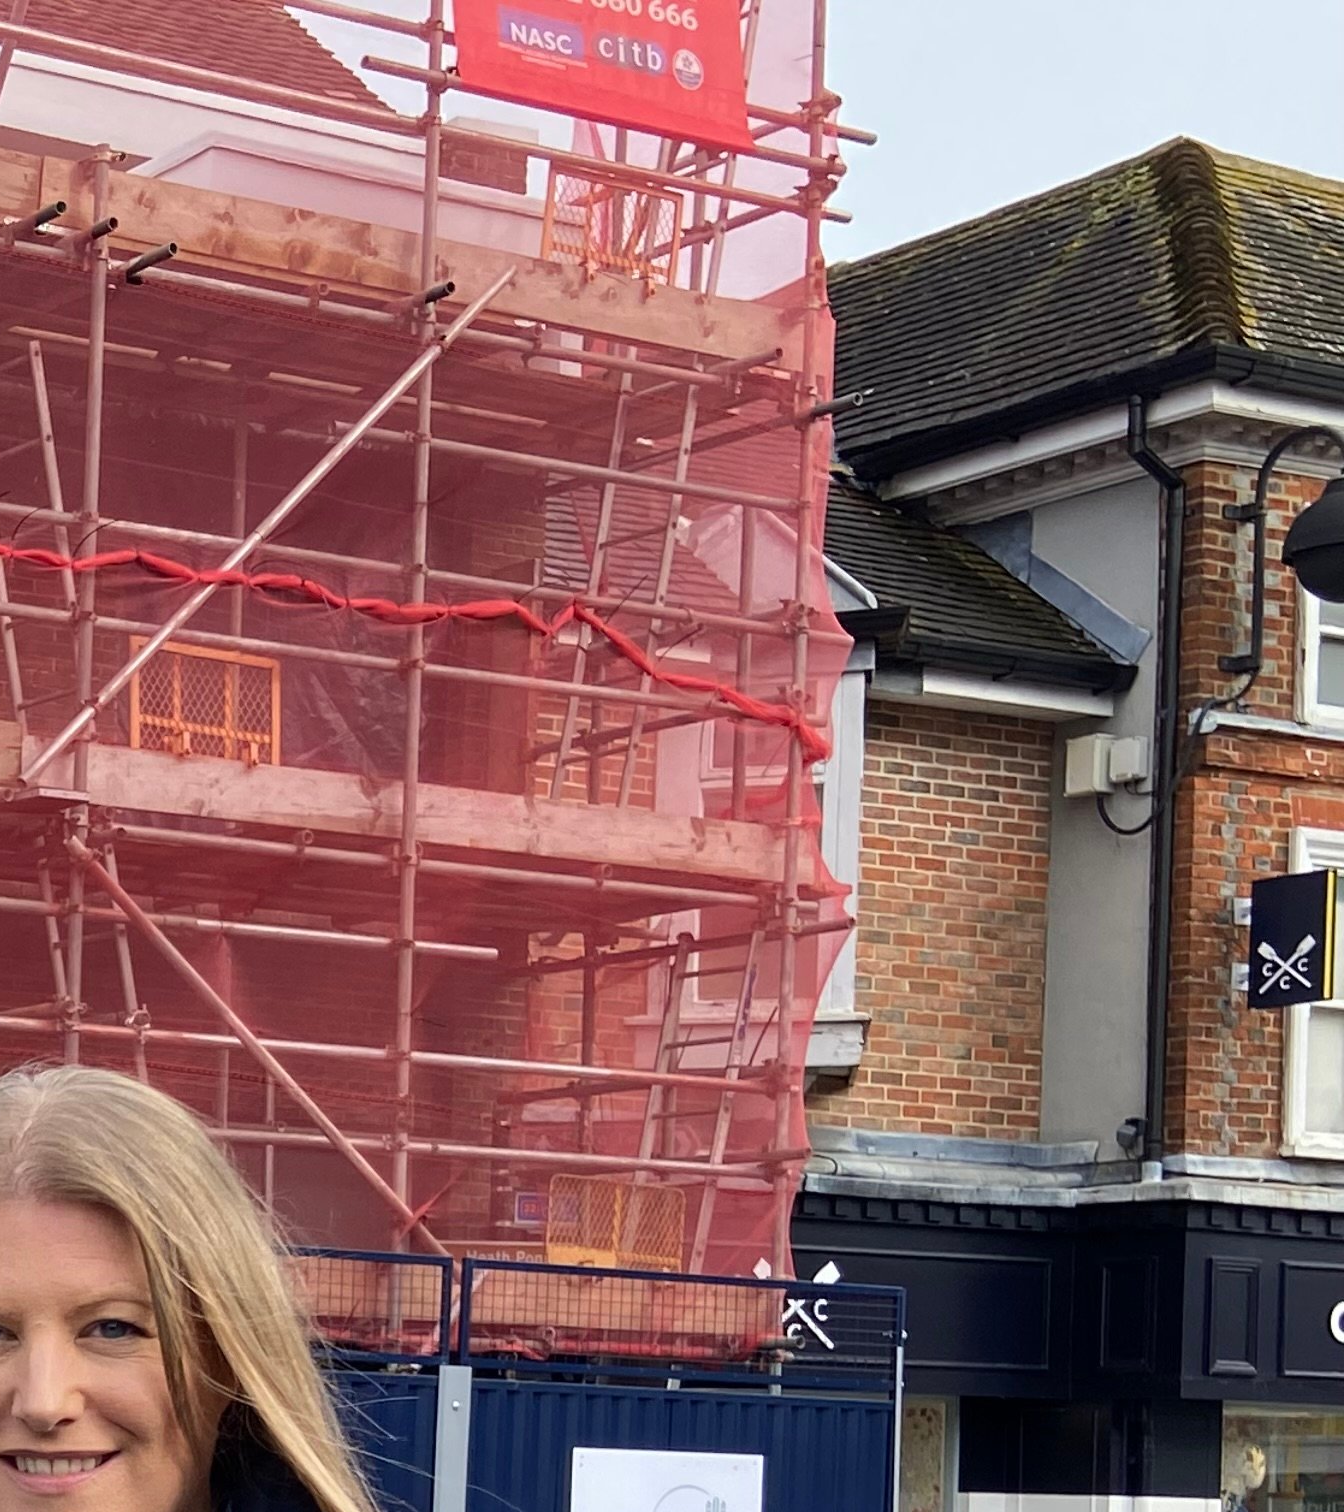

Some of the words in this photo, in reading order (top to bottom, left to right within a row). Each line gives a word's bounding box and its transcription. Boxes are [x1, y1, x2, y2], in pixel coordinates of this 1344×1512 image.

[648, 0, 700, 31] 666
[509, 22, 573, 55] NASC
[598, 36, 663, 71] citb
